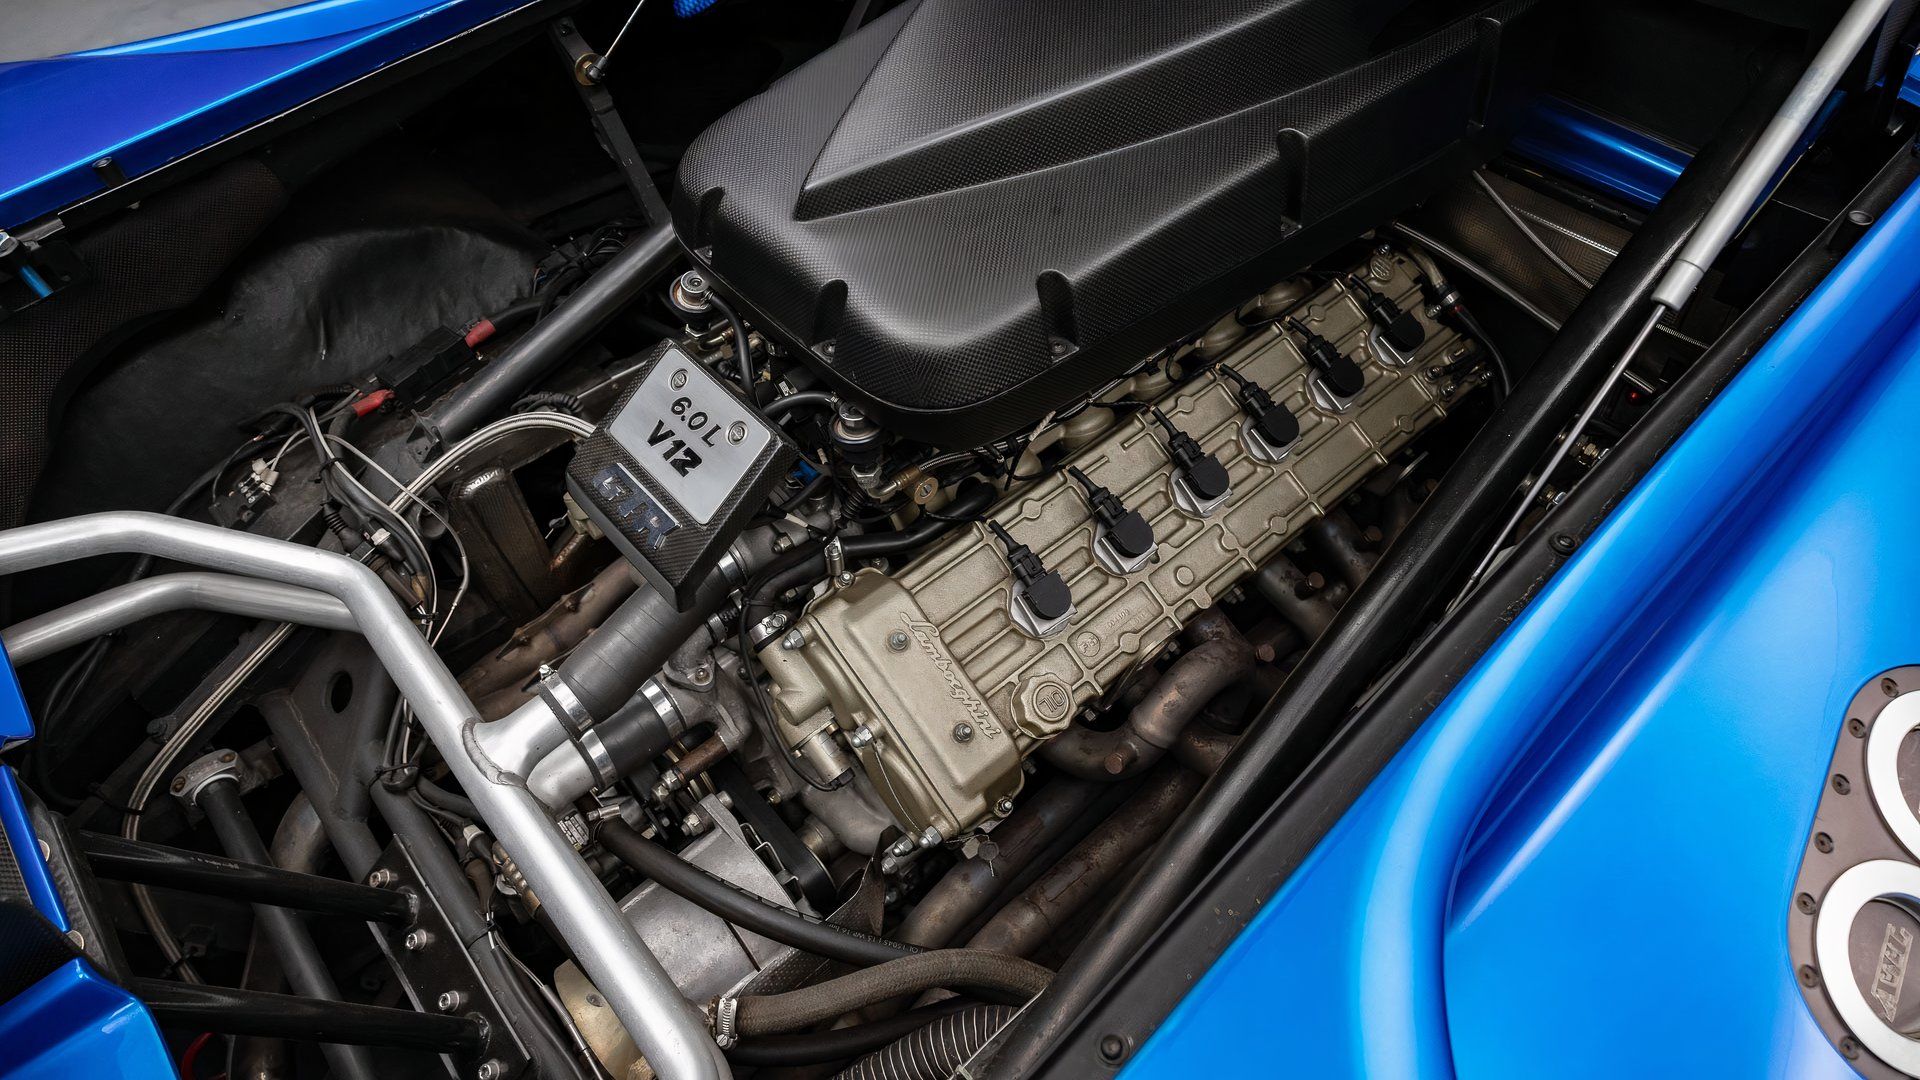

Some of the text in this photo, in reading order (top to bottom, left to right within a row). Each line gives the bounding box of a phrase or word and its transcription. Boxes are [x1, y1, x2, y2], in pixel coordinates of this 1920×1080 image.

[647, 419, 703, 478] V12
[670, 396, 722, 448] 6.0 L
[900, 611, 1001, 740] Lamborghini
[1038, 690, 1066, 714] OIL
